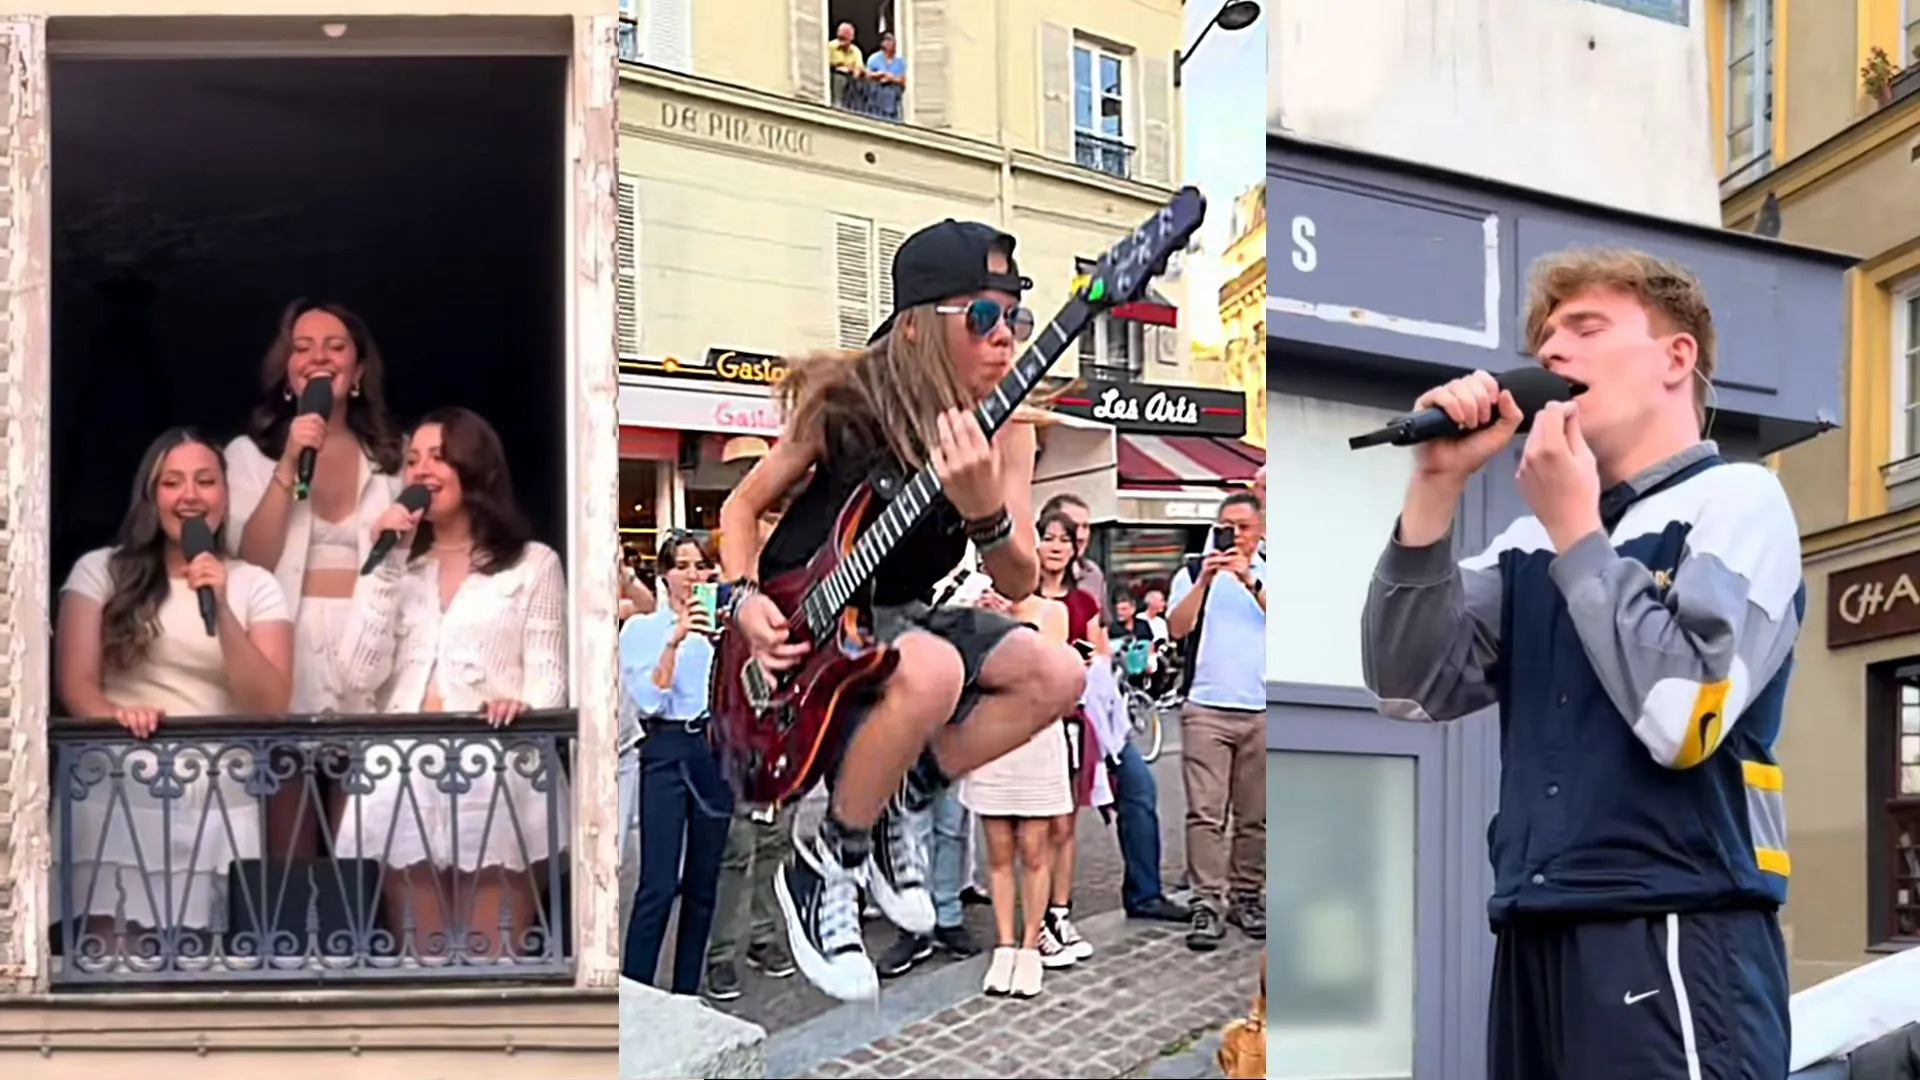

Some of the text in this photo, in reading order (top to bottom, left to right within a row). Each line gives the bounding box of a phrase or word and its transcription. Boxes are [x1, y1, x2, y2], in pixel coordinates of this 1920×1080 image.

[1291, 215, 1317, 272] S
[1093, 388, 1198, 424] Les Arts
[1839, 573, 1920, 624] CHA
